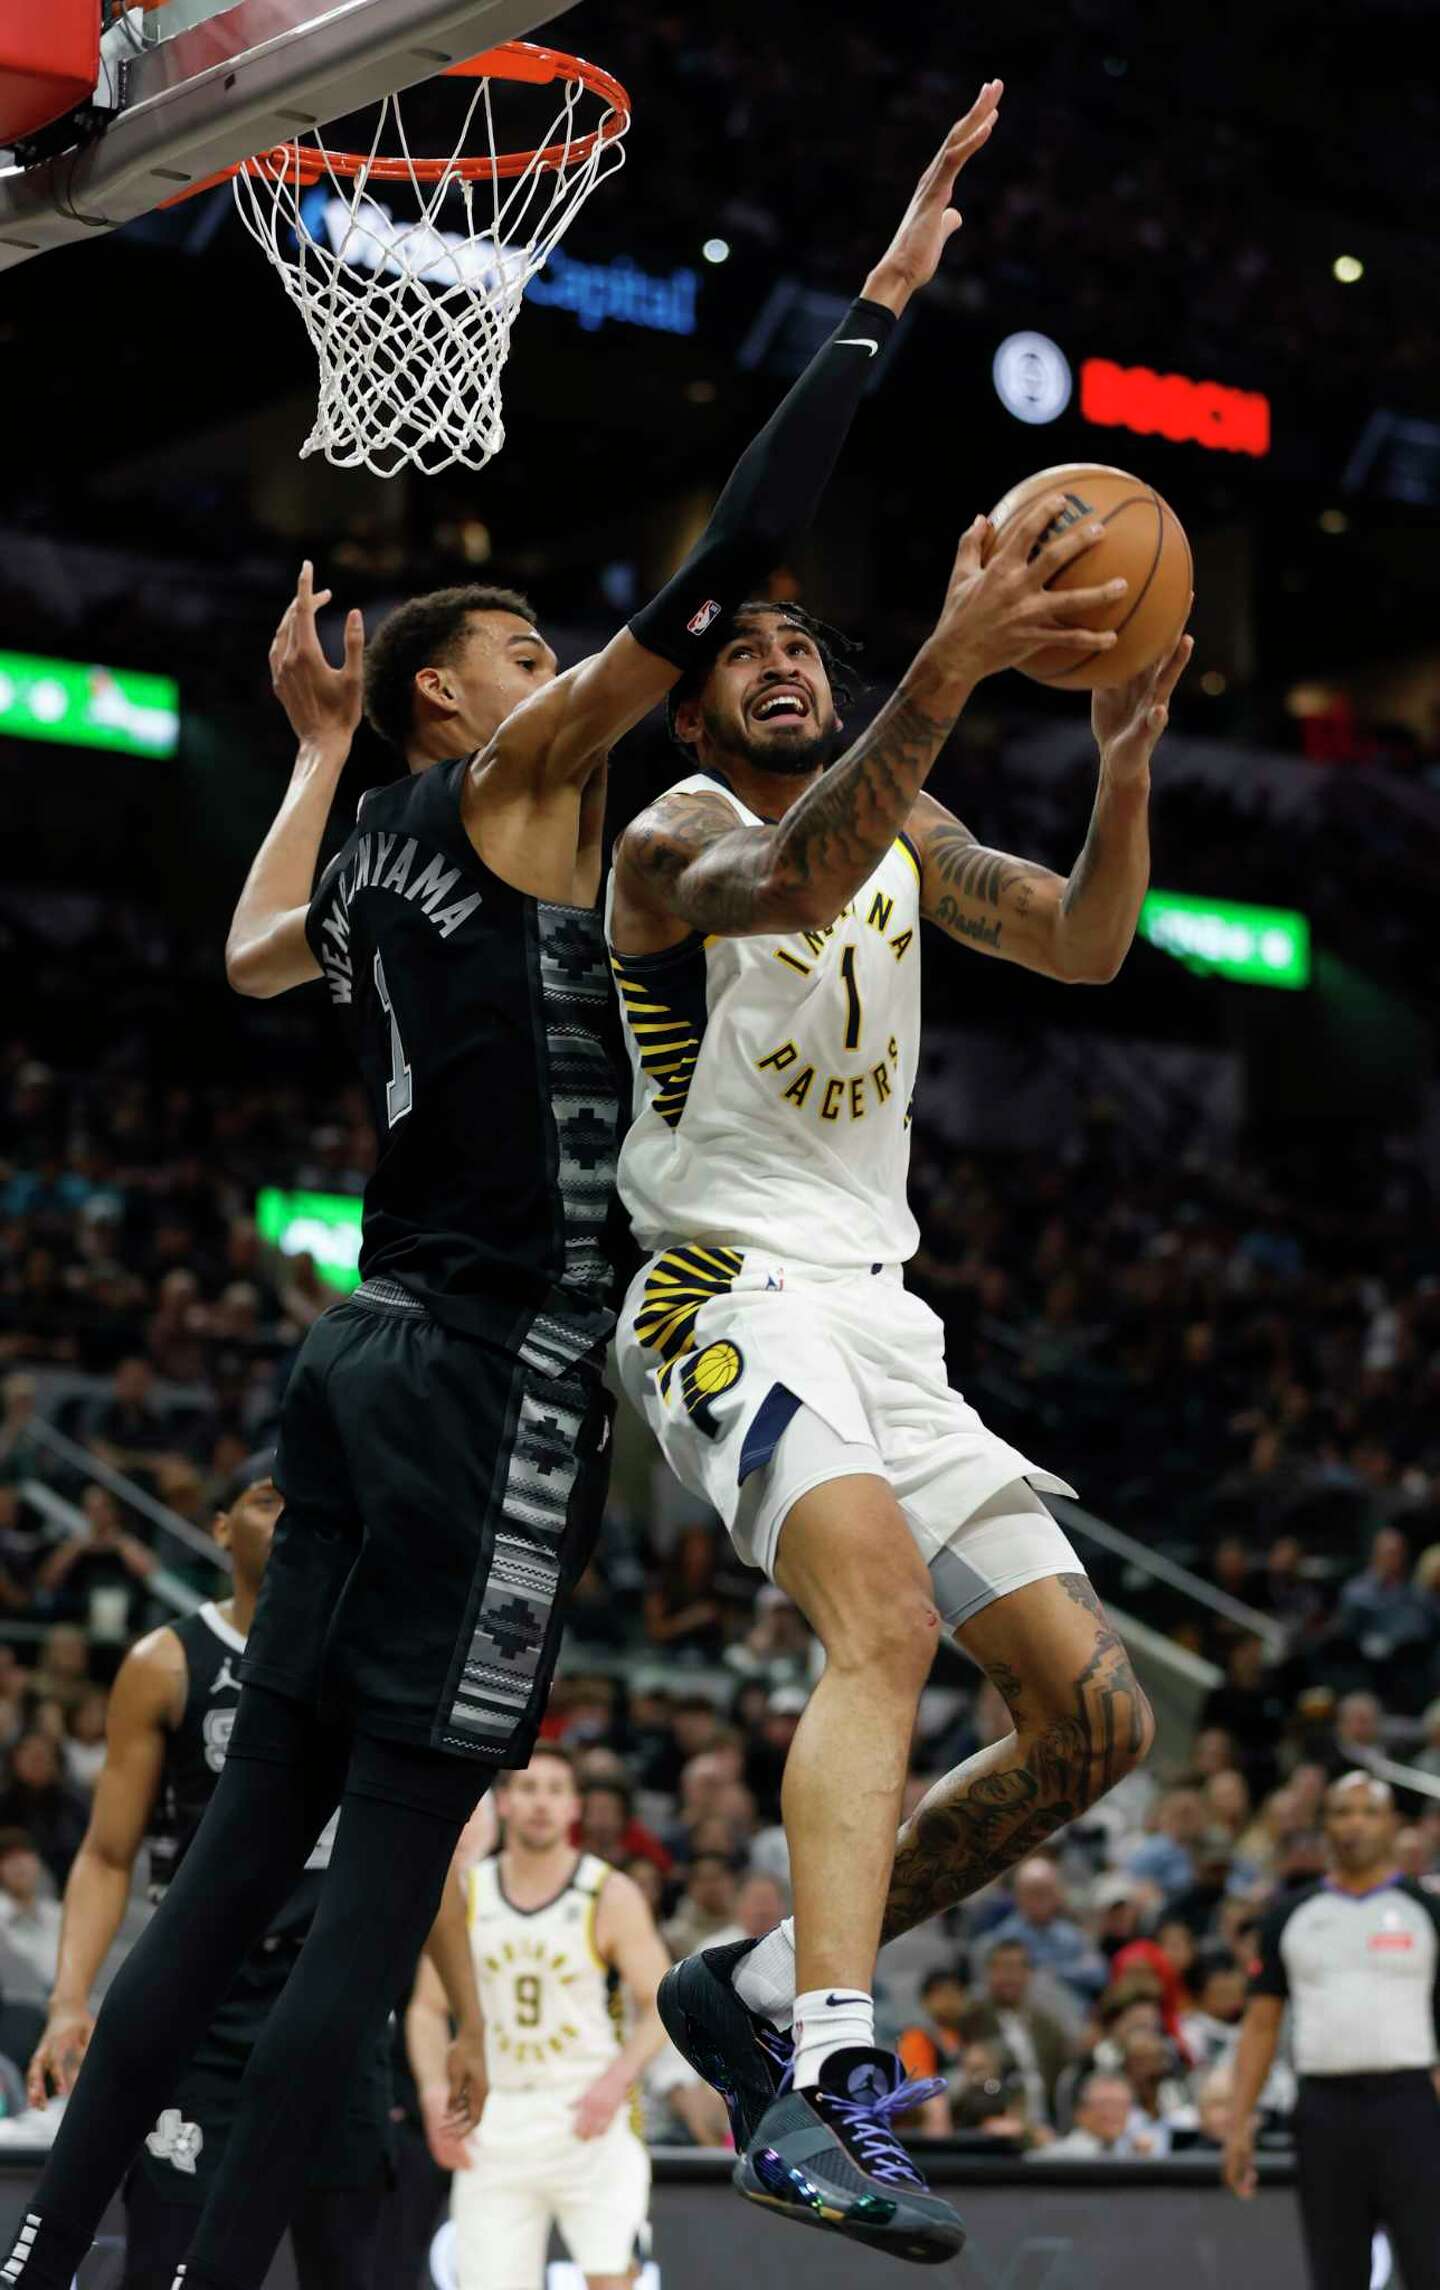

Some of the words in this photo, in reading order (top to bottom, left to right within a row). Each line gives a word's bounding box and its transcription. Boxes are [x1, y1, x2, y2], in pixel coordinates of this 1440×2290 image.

[772, 889, 914, 978] INNA
[373, 946, 413, 1130] 1
[840, 943, 863, 1053] 1
[515, 1974, 542, 2028] 9
